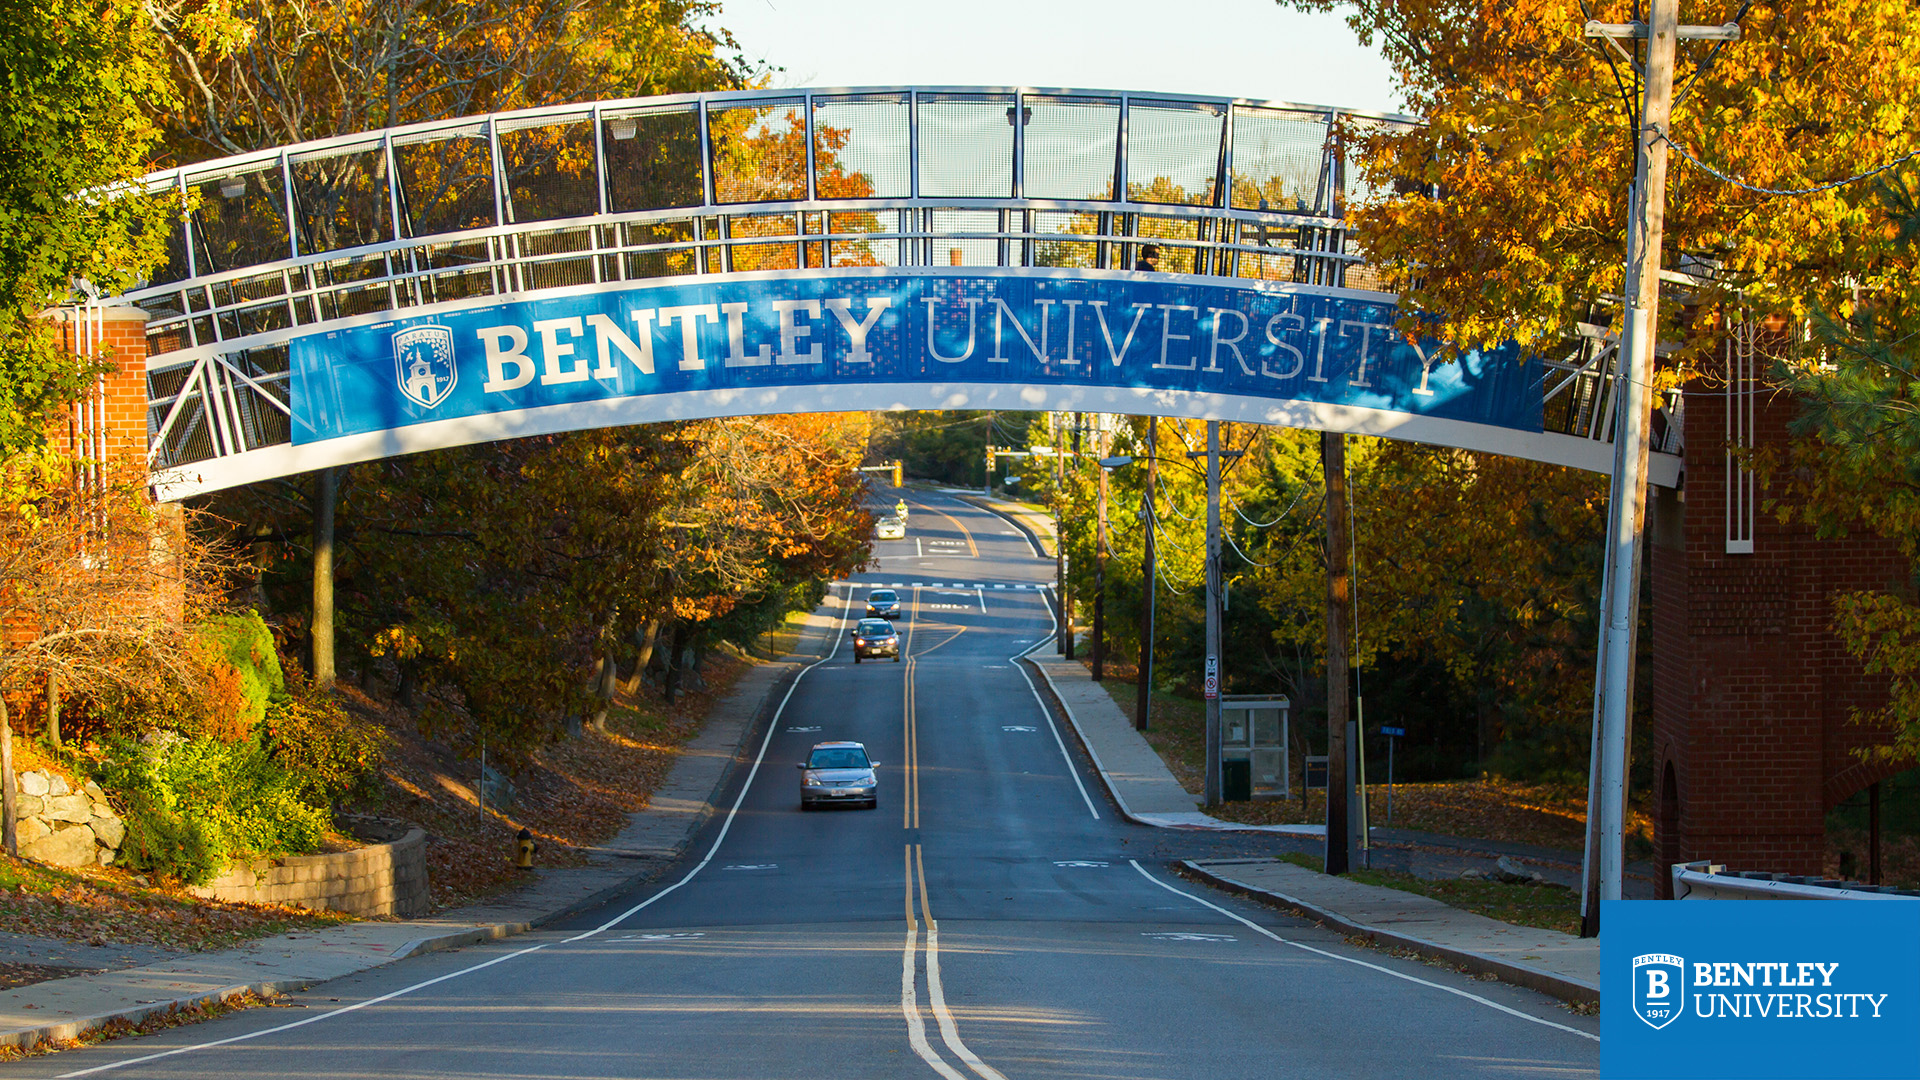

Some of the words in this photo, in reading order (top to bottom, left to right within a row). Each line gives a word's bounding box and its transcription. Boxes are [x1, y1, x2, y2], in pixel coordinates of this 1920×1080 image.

[398, 331, 447, 344] PARATUS
[476, 296, 892, 394] BENTLEY
[920, 296, 1456, 397] UNIVERSITY
